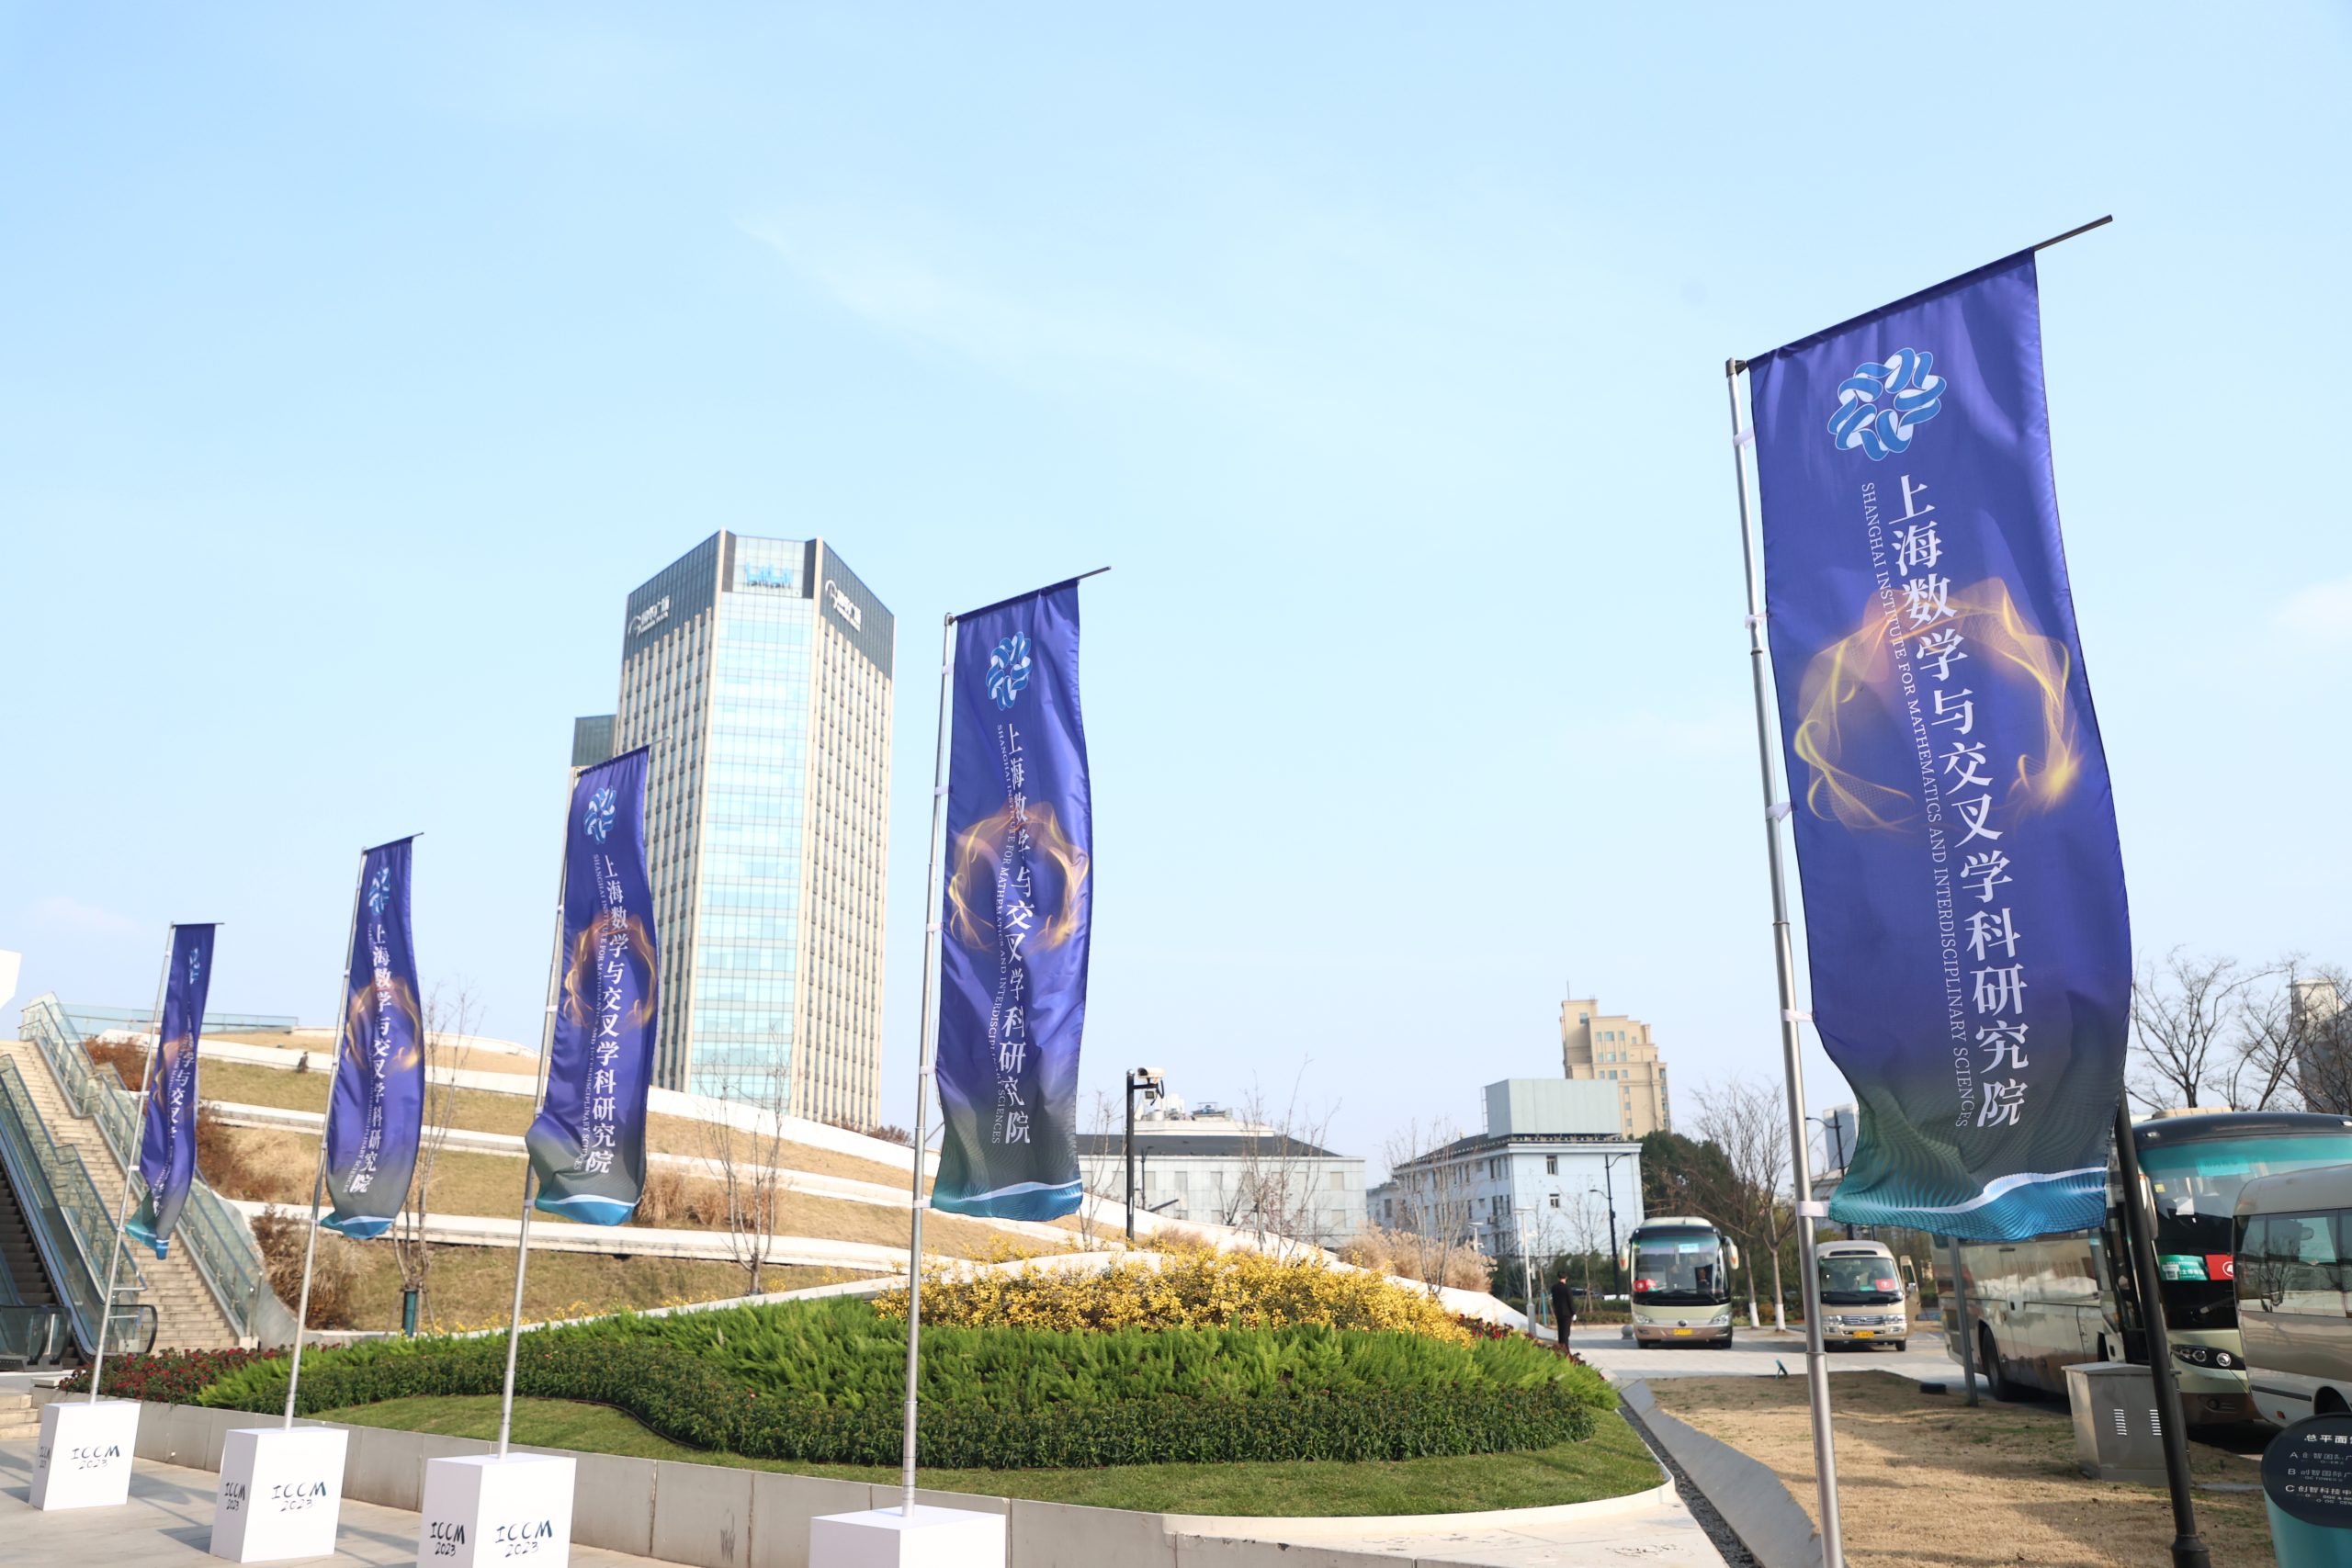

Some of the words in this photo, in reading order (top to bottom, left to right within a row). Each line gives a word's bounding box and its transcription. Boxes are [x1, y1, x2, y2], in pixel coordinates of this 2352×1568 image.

[1861, 482, 1887, 569] SHANGHAI
[1877, 570, 1907, 660] INSTITUTE
[1898, 661, 1917, 696] FOR
[997, 724, 1012, 782] SHANGHAI
[1908, 699, 1942, 823] MATHEMATICS
[1888, 474, 2030, 1128] 上海数学与交叉学科研究院
[1002, 844, 1015, 864] FOR
[1929, 827, 1948, 863] AND
[998, 723, 1035, 1145] 上海数学与交叉学科研究院
[597, 944, 606, 962] FOR
[1000, 949, 1008, 974] AND
[1934, 868, 1967, 1043] INTERDISCIPLINARY
[585, 854, 629, 1174] 上海数学与交叉学科研究院
[1953, 1047, 1975, 1128] SCIENCES
[991, 1089, 1006, 1145] SCIENCES
[2303, 1434, 2352, 1445] 总平面
[71, 1445, 120, 1460] ICCM
[79, 1459, 108, 1470] 2023
[224, 1482, 245, 1501] ICCM
[271, 1481, 327, 1500] ICCM
[280, 1498, 313, 1512] 2023
[430, 1521, 465, 1545] ICCM
[495, 1519, 553, 1543] ICCM
[435, 1541, 457, 1557] 2023
[505, 1541, 539, 1558] 2023
